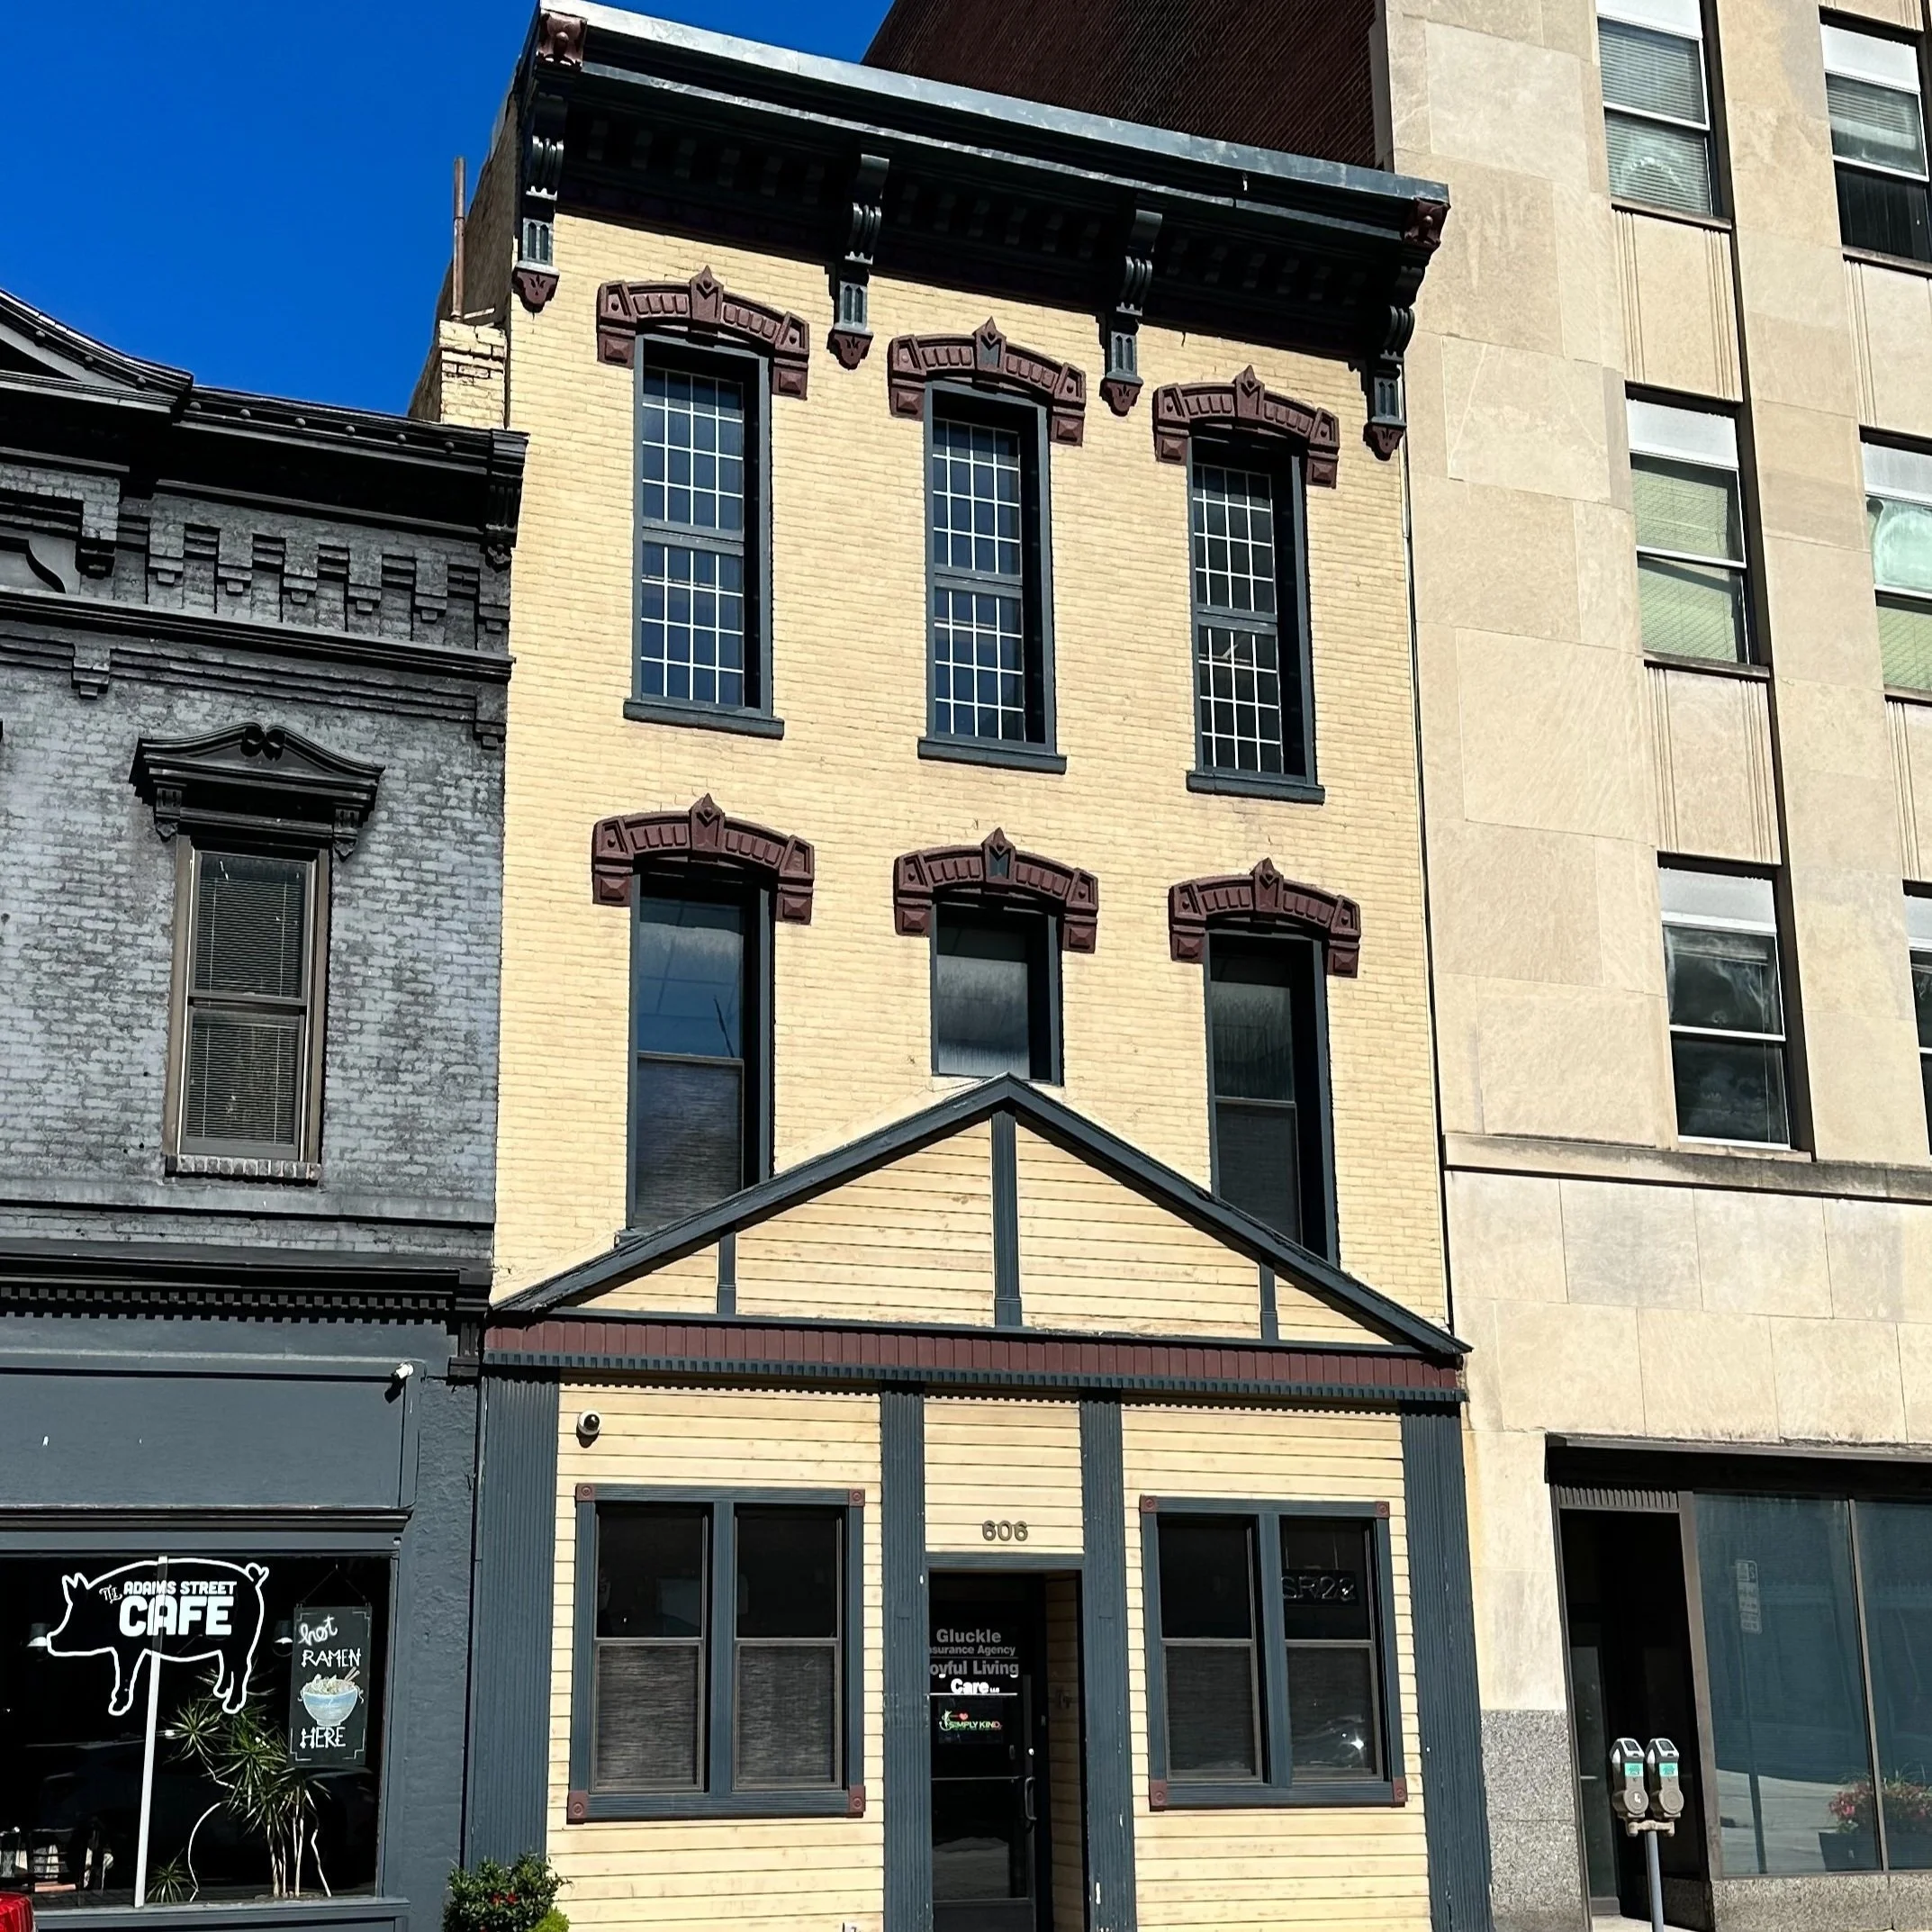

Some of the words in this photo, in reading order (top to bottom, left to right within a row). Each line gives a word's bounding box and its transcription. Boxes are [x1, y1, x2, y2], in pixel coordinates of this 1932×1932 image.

[982, 1520, 1028, 1541] 606
[123, 1580, 176, 1595] ADAMS
[180, 1581, 237, 1595] STREET
[119, 1594, 234, 1637] CAFE
[298, 1615, 338, 1646] hot
[936, 1629, 1001, 1643] Gluckle
[302, 1648, 361, 1667] RAMEN
[929, 1646, 974, 1655] surance
[977, 1645, 1016, 1657] Agency
[929, 1660, 968, 1679] oyful
[972, 1660, 1019, 1679] Living
[951, 1678, 989, 1694] Care
[300, 1727, 346, 1749] HERE
